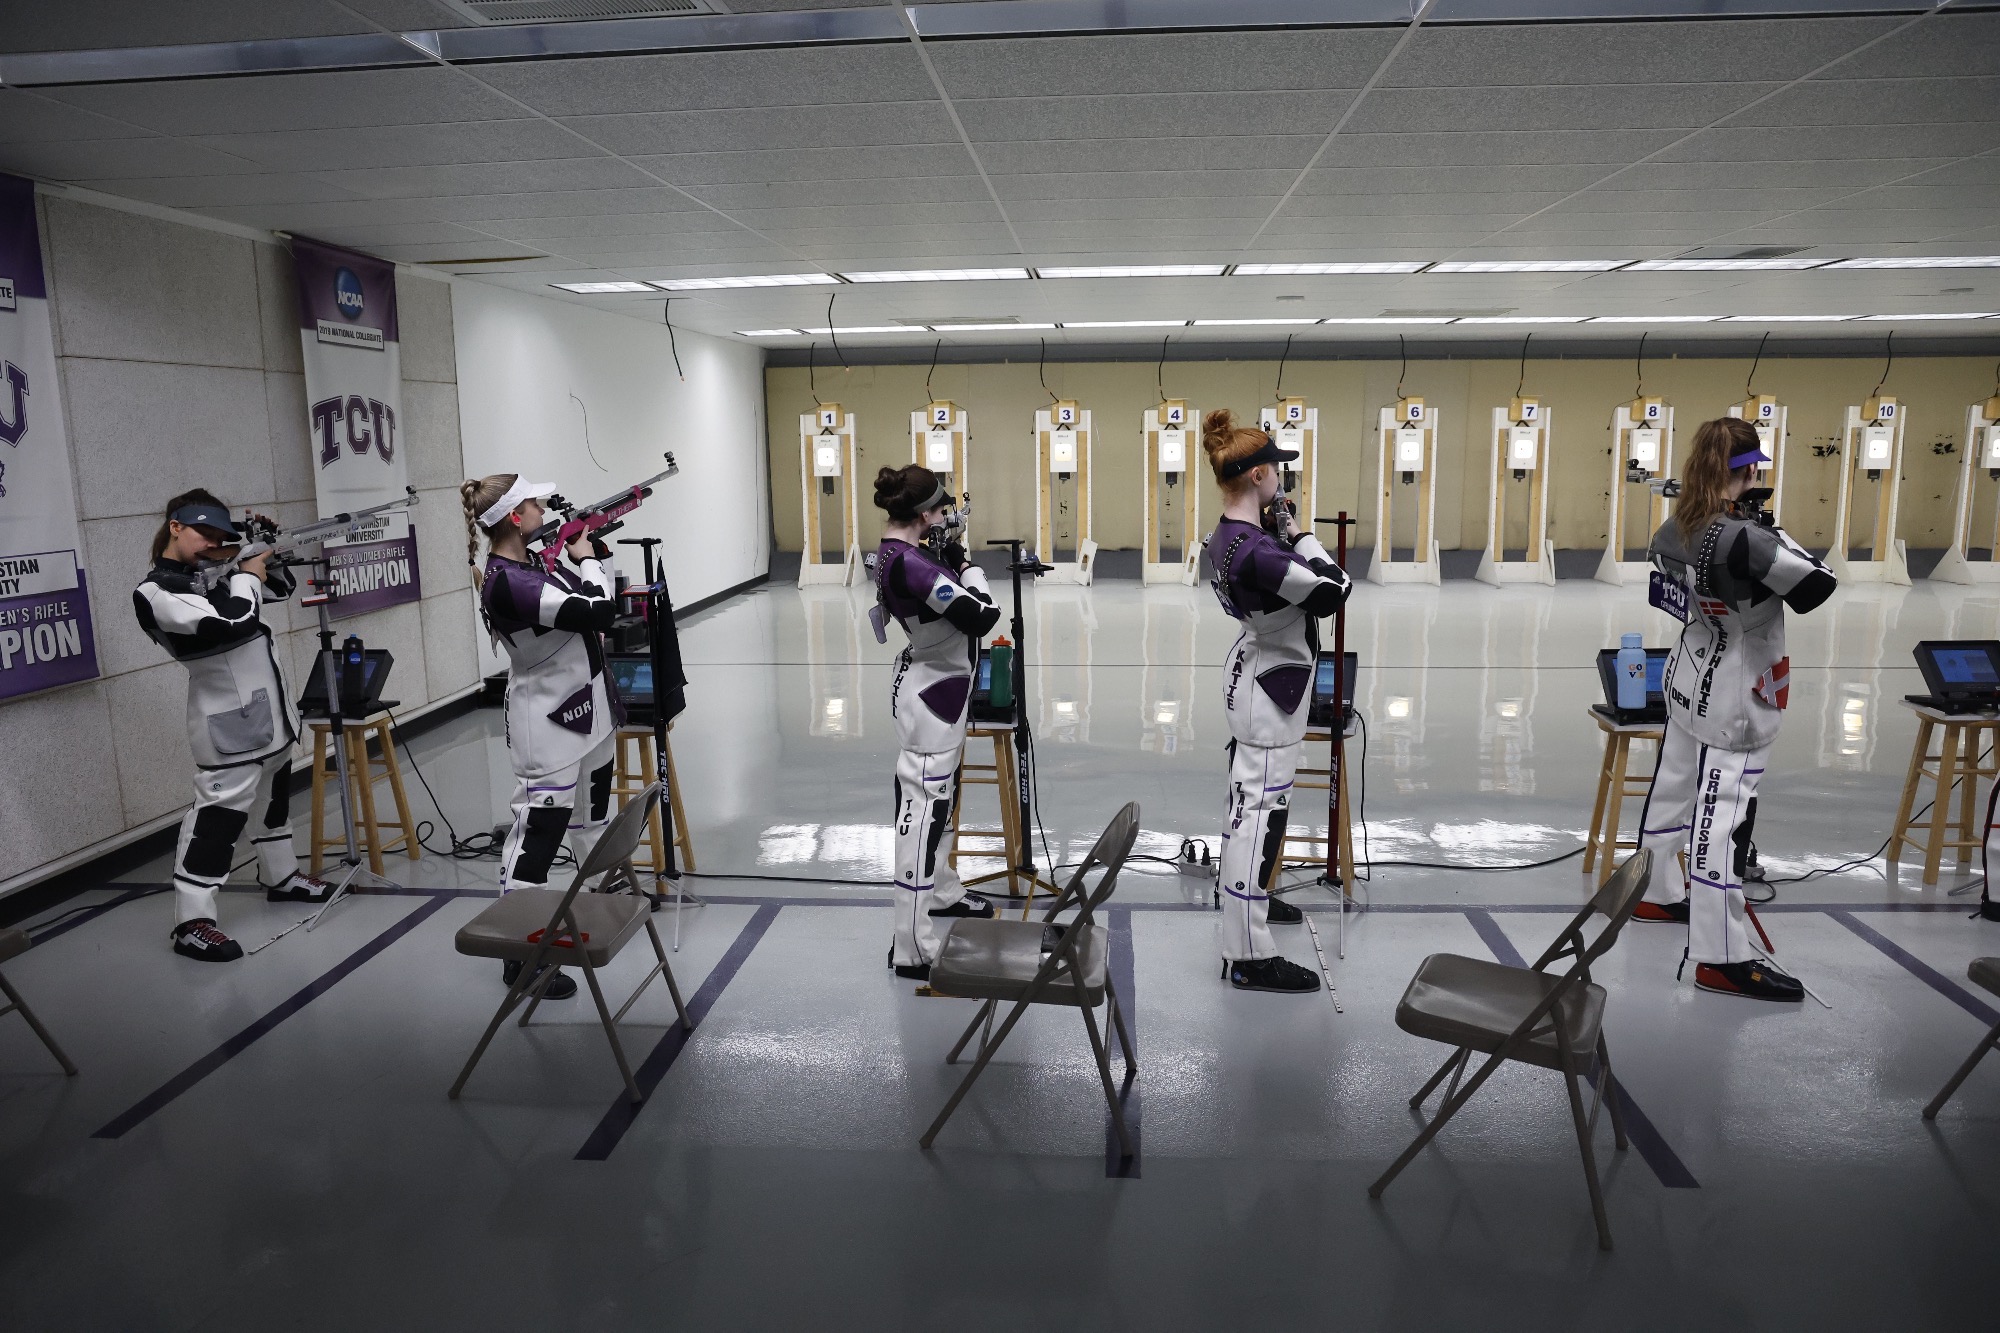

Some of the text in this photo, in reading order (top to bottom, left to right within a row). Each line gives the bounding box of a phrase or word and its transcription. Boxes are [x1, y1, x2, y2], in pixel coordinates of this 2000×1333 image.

[338, 291, 363, 308] NCAA
[332, 328, 355, 339] NATIONAL
[355, 331, 382, 343] COLLEGIATE
[825, 414, 832, 424] 1
[937, 411, 946, 421] 2
[1062, 410, 1071, 421] 3
[1170, 410, 1180, 421] 4
[1290, 408, 1299, 419] 5
[1410, 407, 1420, 418] 6
[1525, 407, 1535, 418] 7
[1648, 406, 1658, 417] 8
[1762, 406, 1772, 417] 9
[1880, 406, 1894, 417] 10
[312, 395, 395, 470] TCU
[346, 529, 384, 543] UNIVERSITY
[348, 553, 354, 563] &
[386, 546, 406, 557] RIFLE
[330, 558, 411, 597] CHAMPION
[1663, 582, 1686, 608] TCU
[34, 601, 70, 621] RIFLE
[1697, 615, 1728, 718] STEPHANIE
[1226, 648, 1245, 711] KATIE
[1671, 686, 1691, 711] DEN
[563, 700, 592, 723] NOR
[899, 799, 913, 836] TCU
